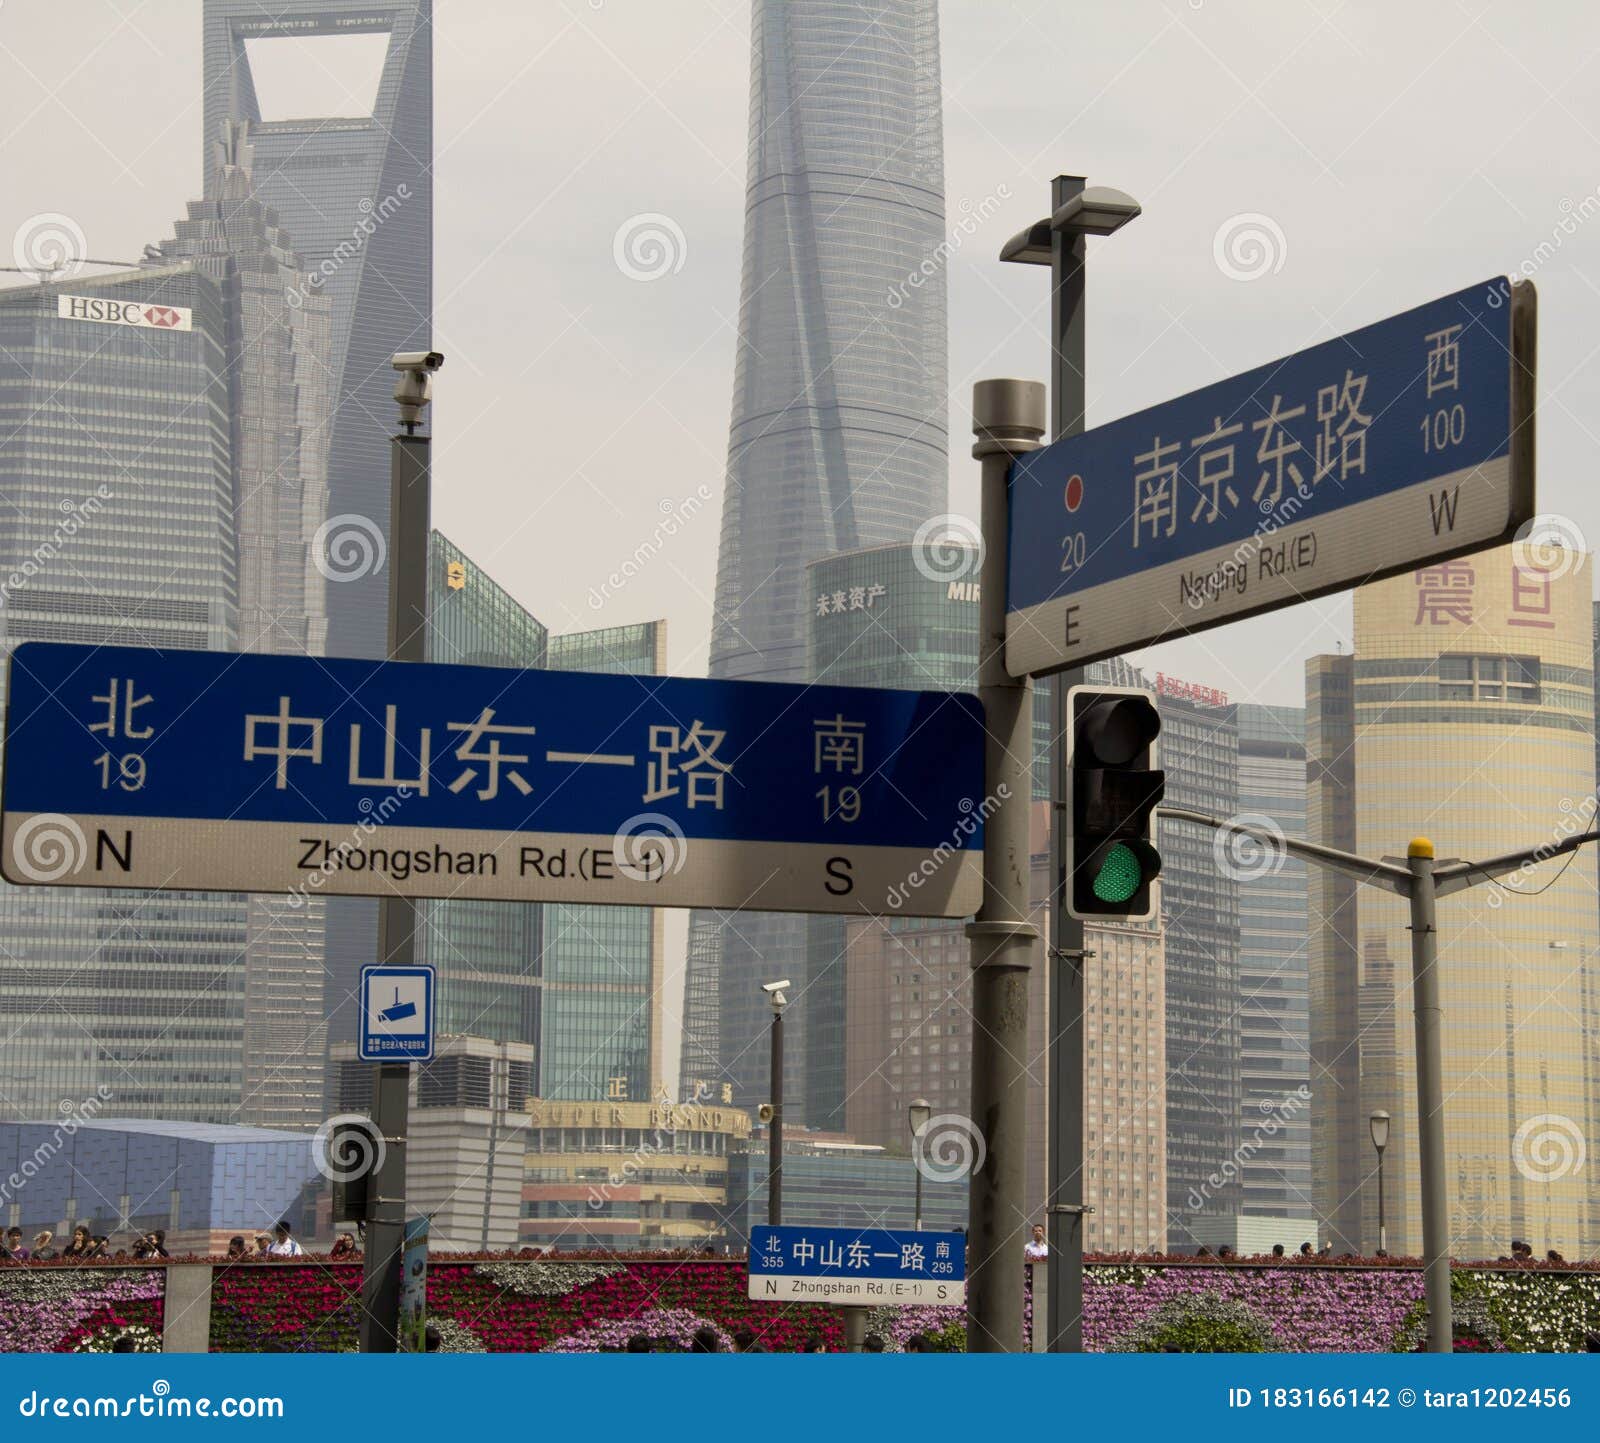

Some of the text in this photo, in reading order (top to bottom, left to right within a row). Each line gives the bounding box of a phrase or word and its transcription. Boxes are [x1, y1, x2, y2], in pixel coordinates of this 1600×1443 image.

[69, 297, 141, 324] HSBC
[1424, 322, 1463, 399] 西
[1419, 404, 1465, 454] 100
[1132, 368, 1373, 548] 南京东路
[1429, 484, 1459, 536] W
[1061, 532, 1086, 573] 20
[1180, 531, 1317, 603] Nanjing Rd.(E)
[816, 583, 887, 616] 未来资产
[1065, 604, 1081, 647] E
[89, 678, 155, 739] 北
[243, 695, 733, 810] 中山东一路
[813, 713, 866, 777] 南
[94, 753, 147, 791] 19
[815, 785, 862, 823] 19
[96, 829, 132, 872] N
[297, 838, 497, 881] Zhongshan
[824, 857, 854, 895] S
[762, 1256, 784, 1268] 355
[765, 1235, 781, 1253] 北
[792, 1237, 926, 1271] 中山东一路
[935, 1240, 950, 1259] 南
[932, 1262, 953, 1273] 295
[766, 1280, 777, 1294] N
[791, 1280, 860, 1297] Zhongshan
[937, 1285, 947, 1299] S
